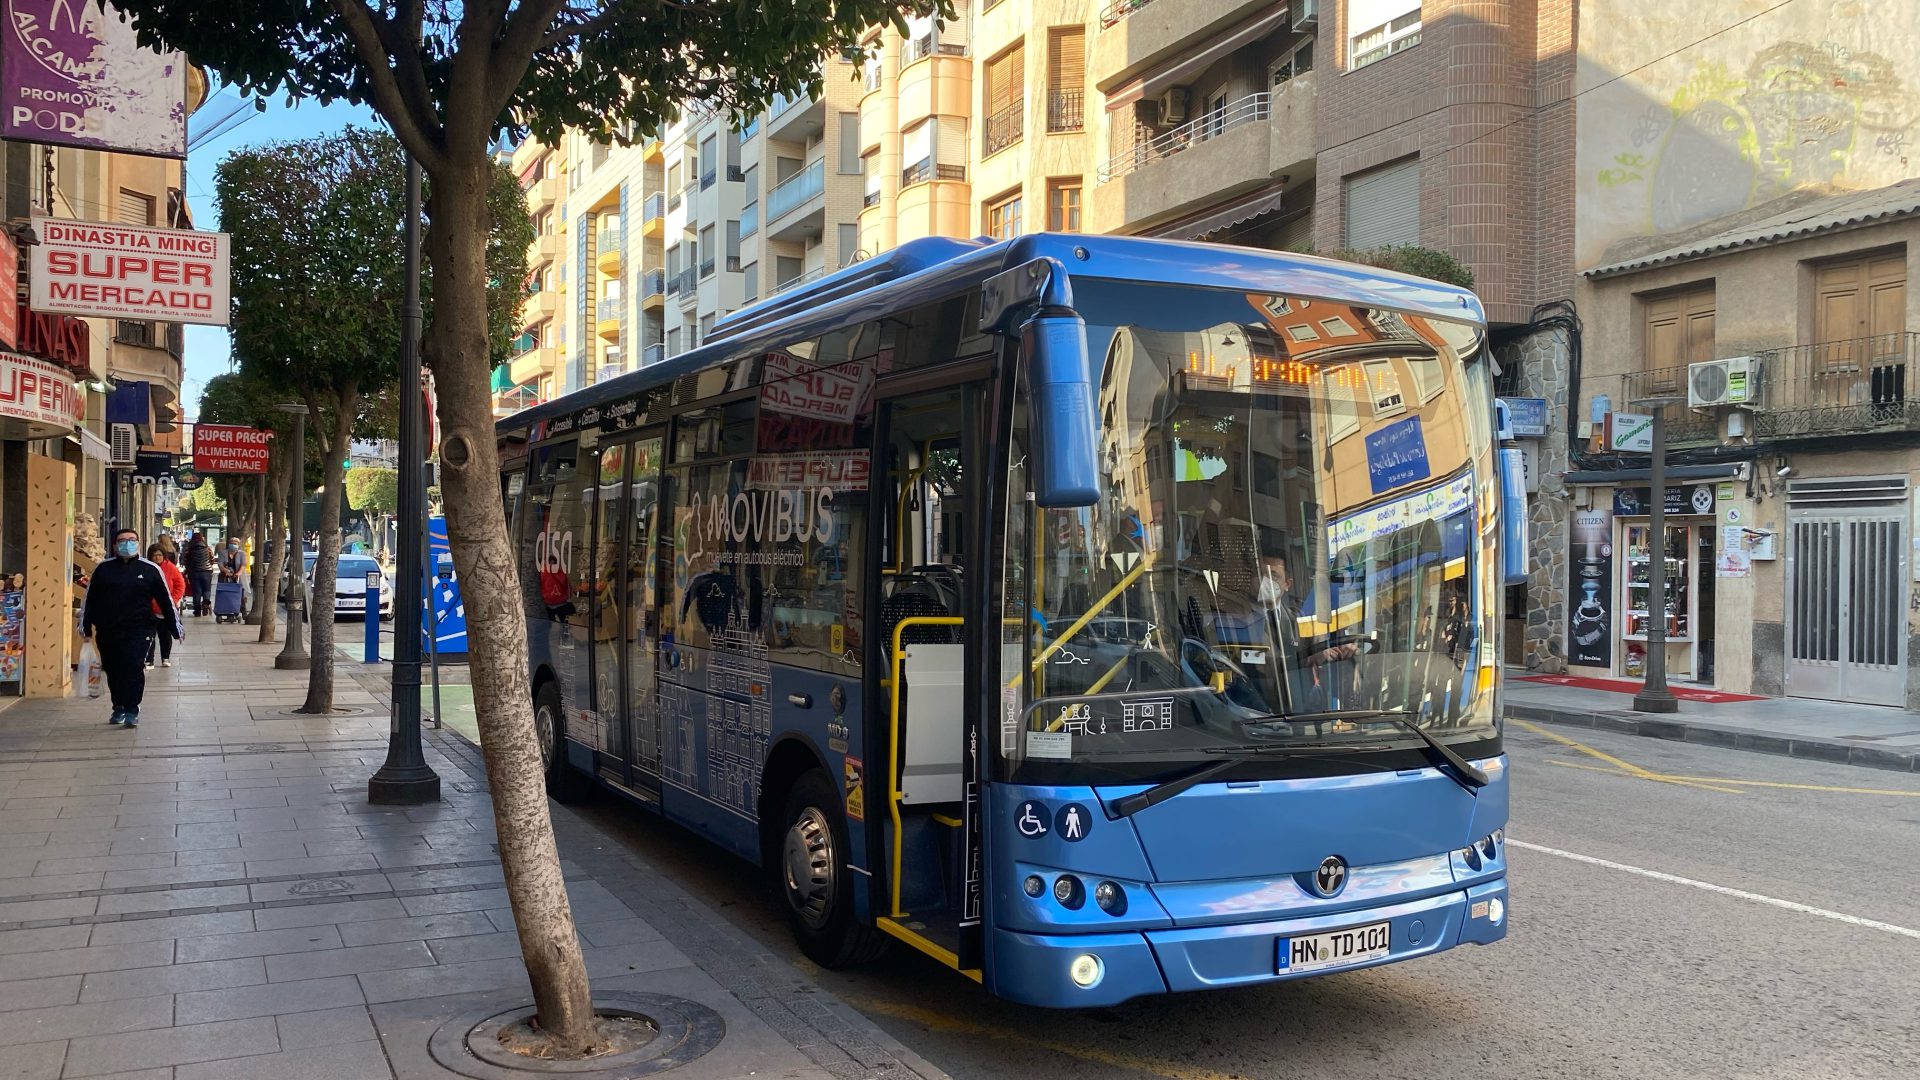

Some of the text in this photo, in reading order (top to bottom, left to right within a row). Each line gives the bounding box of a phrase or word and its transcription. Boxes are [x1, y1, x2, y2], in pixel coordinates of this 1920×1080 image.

[50, 227, 212, 253] DINASTIA MING
[48, 250, 213, 287] SUPER
[49, 281, 212, 311] MERCADO
[198, 429, 233, 442] SUPER
[197, 446, 269, 459] ALIMENTACIO
[210, 459, 261, 470] Y MENAJE
[706, 486, 834, 543] MOVIBUS
[1577, 517, 1605, 525] CITIZEN
[535, 530, 573, 574] alsa
[734, 553, 743, 563] en
[744, 550, 772, 566] autobús
[773, 548, 804, 567] eléctrico
[1281, 956, 1287, 964] D
[1291, 939, 1318, 964] HN
